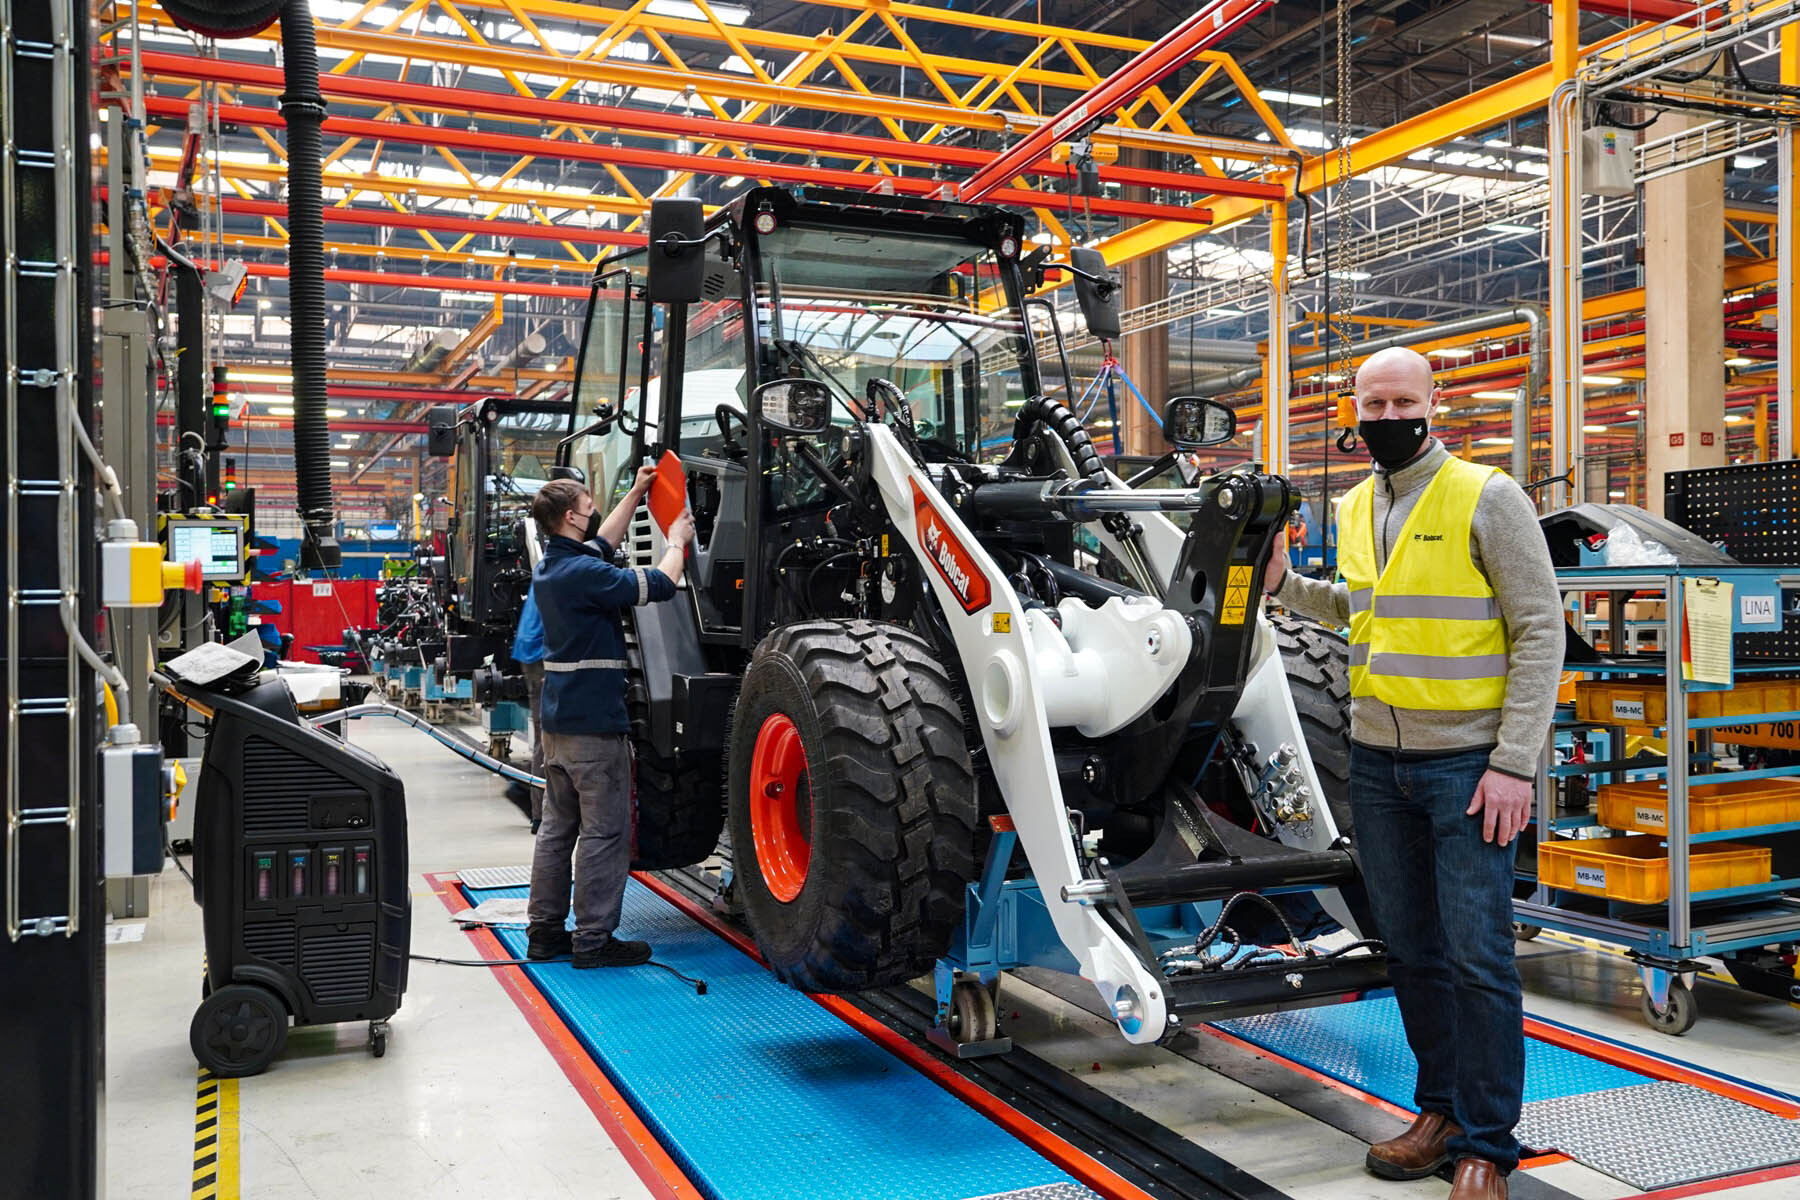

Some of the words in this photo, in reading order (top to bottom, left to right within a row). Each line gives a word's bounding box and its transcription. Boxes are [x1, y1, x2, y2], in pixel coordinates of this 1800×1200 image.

[1745, 600, 1771, 615] LINA
[1615, 705, 1642, 715] MB-MC
[1768, 722, 1794, 739] 700
[1637, 812, 1664, 823] MB-MC
[1577, 871, 1605, 883] MB-MC
